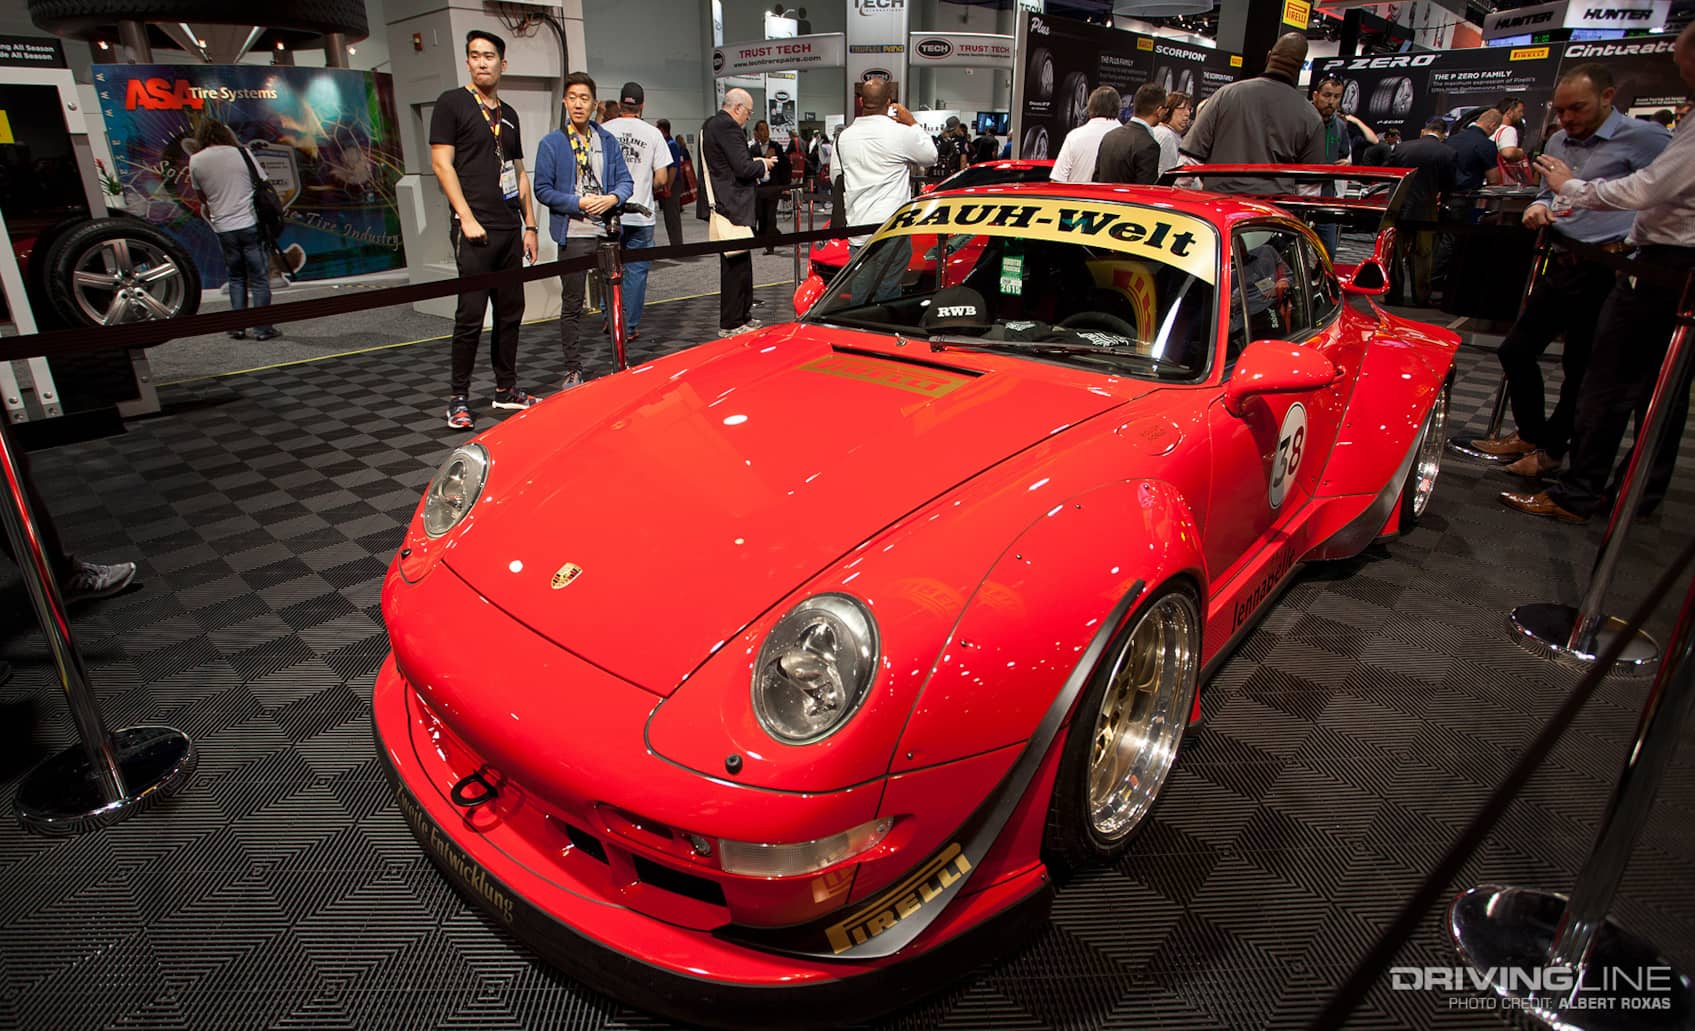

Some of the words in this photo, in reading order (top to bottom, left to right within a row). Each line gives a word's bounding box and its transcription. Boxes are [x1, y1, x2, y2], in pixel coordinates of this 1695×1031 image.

[1287, 1, 1308, 26] PIRELLI
[1494, 11, 1554, 31] HUNTER
[1583, 8, 1653, 20] HUNTER
[1031, 16, 1050, 35] Plus
[23, 52, 53, 60] Season
[25, 44, 54, 52] Season
[739, 47, 772, 59] TRUST
[776, 44, 811, 55] TECH
[922, 44, 948, 53] TECH
[960, 44, 987, 53] TRUST
[991, 46, 1010, 54] TECH
[1155, 45, 1207, 62] SCORPION
[1323, 60, 1344, 71] P
[1347, 55, 1436, 70] ZERO
[1481, 70, 1512, 78] FAMILY
[125, 77, 205, 111] ASA
[189, 87, 219, 100] Tire
[221, 87, 278, 102] Systems
[343, 223, 400, 251] Industry
[886, 203, 1197, 258] RAUH-Welt
[937, 305, 977, 318] RWB
[1272, 425, 1305, 488] 38
[430, 826, 514, 922] Entwicklung
[825, 842, 972, 955] PIRELLI
